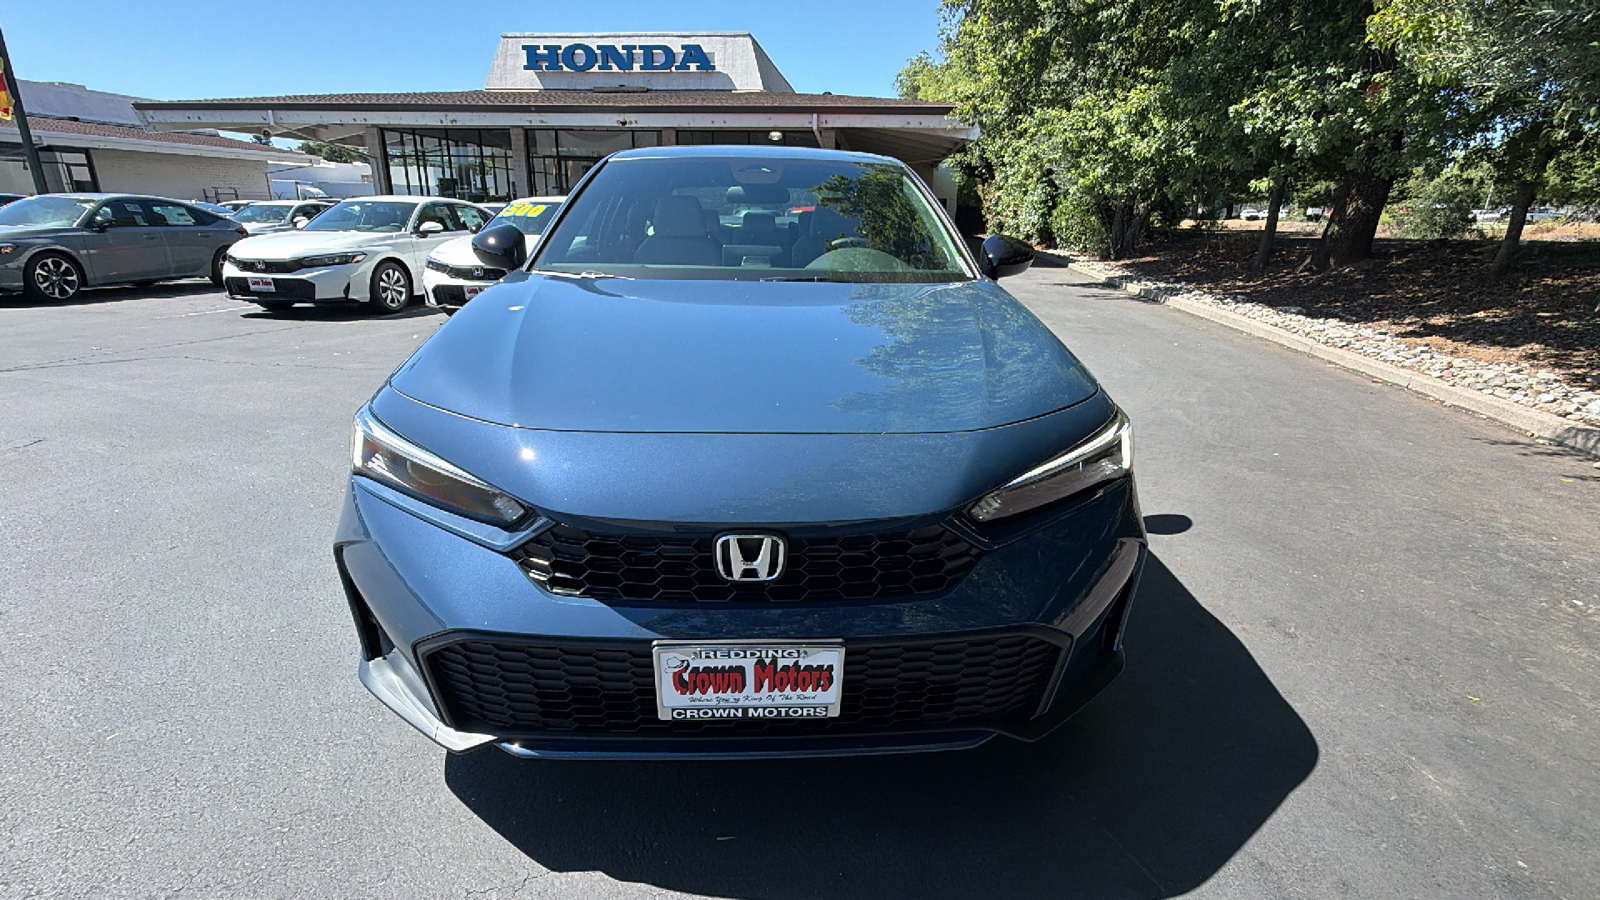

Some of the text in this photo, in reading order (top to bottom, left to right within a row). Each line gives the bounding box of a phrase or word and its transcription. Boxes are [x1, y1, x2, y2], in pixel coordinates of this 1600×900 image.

[521, 43, 716, 72] HONDA
[701, 650, 798, 658] REDDING
[672, 659, 834, 695] Crown Motors
[743, 694, 762, 702] King
[766, 694, 776, 702] Of
[672, 707, 827, 718] CROWN MOTORS
